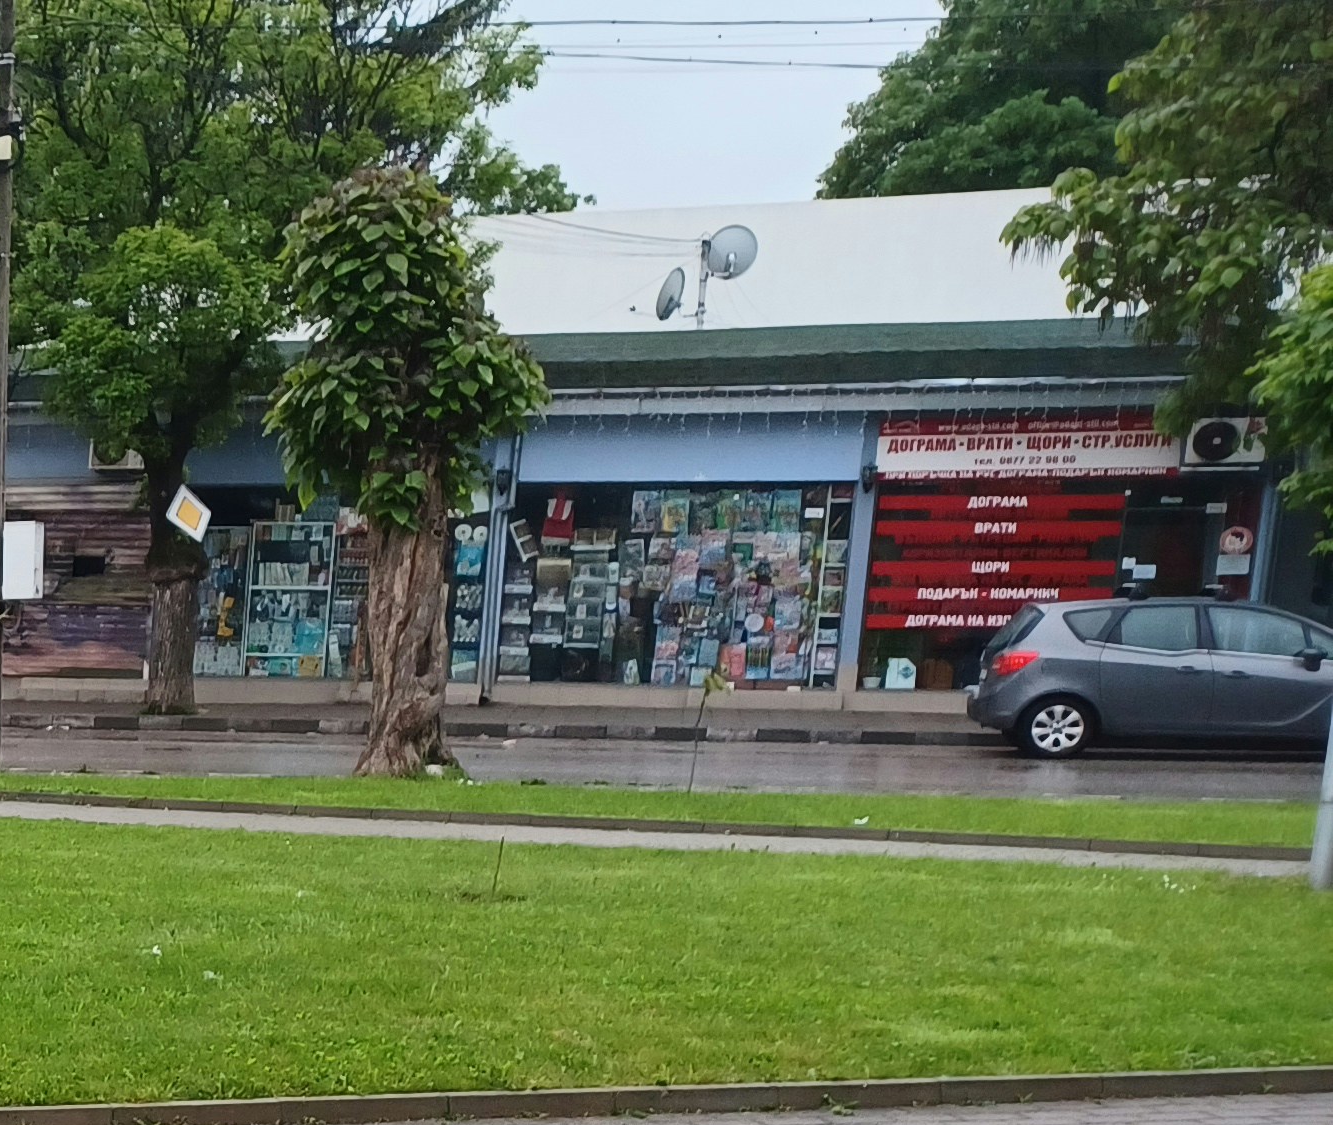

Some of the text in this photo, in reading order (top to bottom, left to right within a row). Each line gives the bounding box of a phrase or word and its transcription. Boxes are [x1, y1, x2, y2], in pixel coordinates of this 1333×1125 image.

[887, 432, 1172, 454] ДОГРАМА ВРАТИ ЩОРИ СТР.УСЛУГИ
[967, 495, 1028, 509] ДОГРАМА
[974, 521, 1018, 534] ВРАТИ
[971, 561, 1010, 574] ЩОРИ
[905, 614, 965, 628] ДОГРАМА
[968, 614, 985, 627] НА
